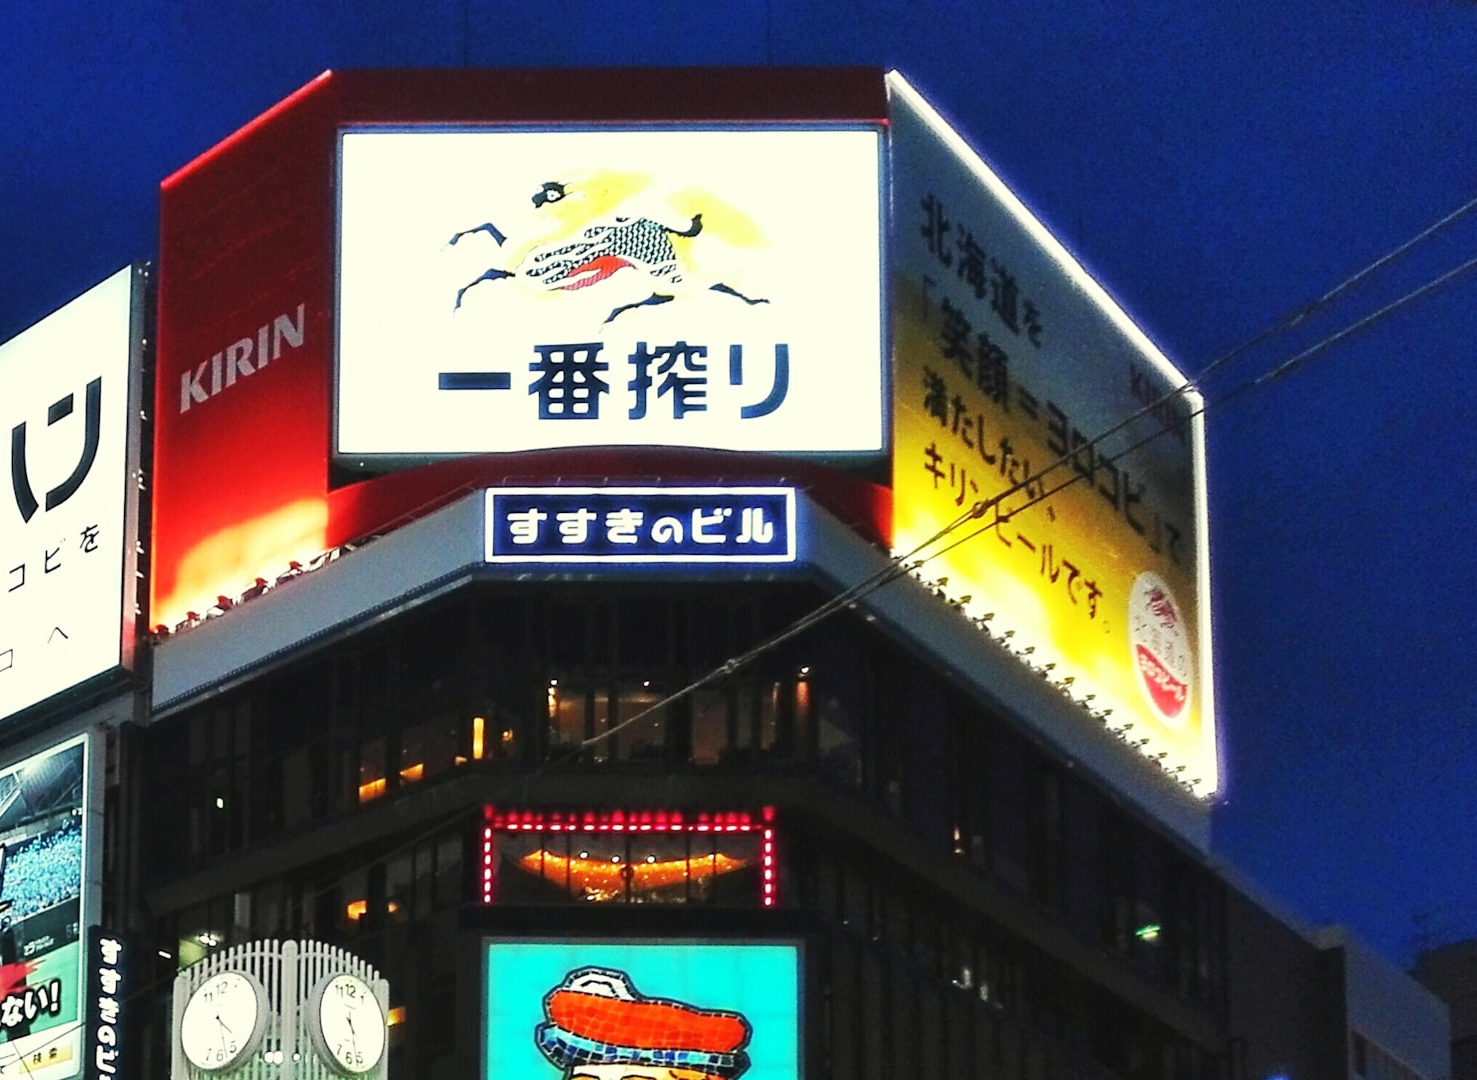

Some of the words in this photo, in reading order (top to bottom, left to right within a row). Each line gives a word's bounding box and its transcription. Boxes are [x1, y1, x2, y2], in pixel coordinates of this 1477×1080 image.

[180, 303, 305, 414] KIRIN
[438, 341, 790, 420] 一番搾り
[506, 508, 775, 544] すすきのビル
[345, 983, 357, 999] 12
